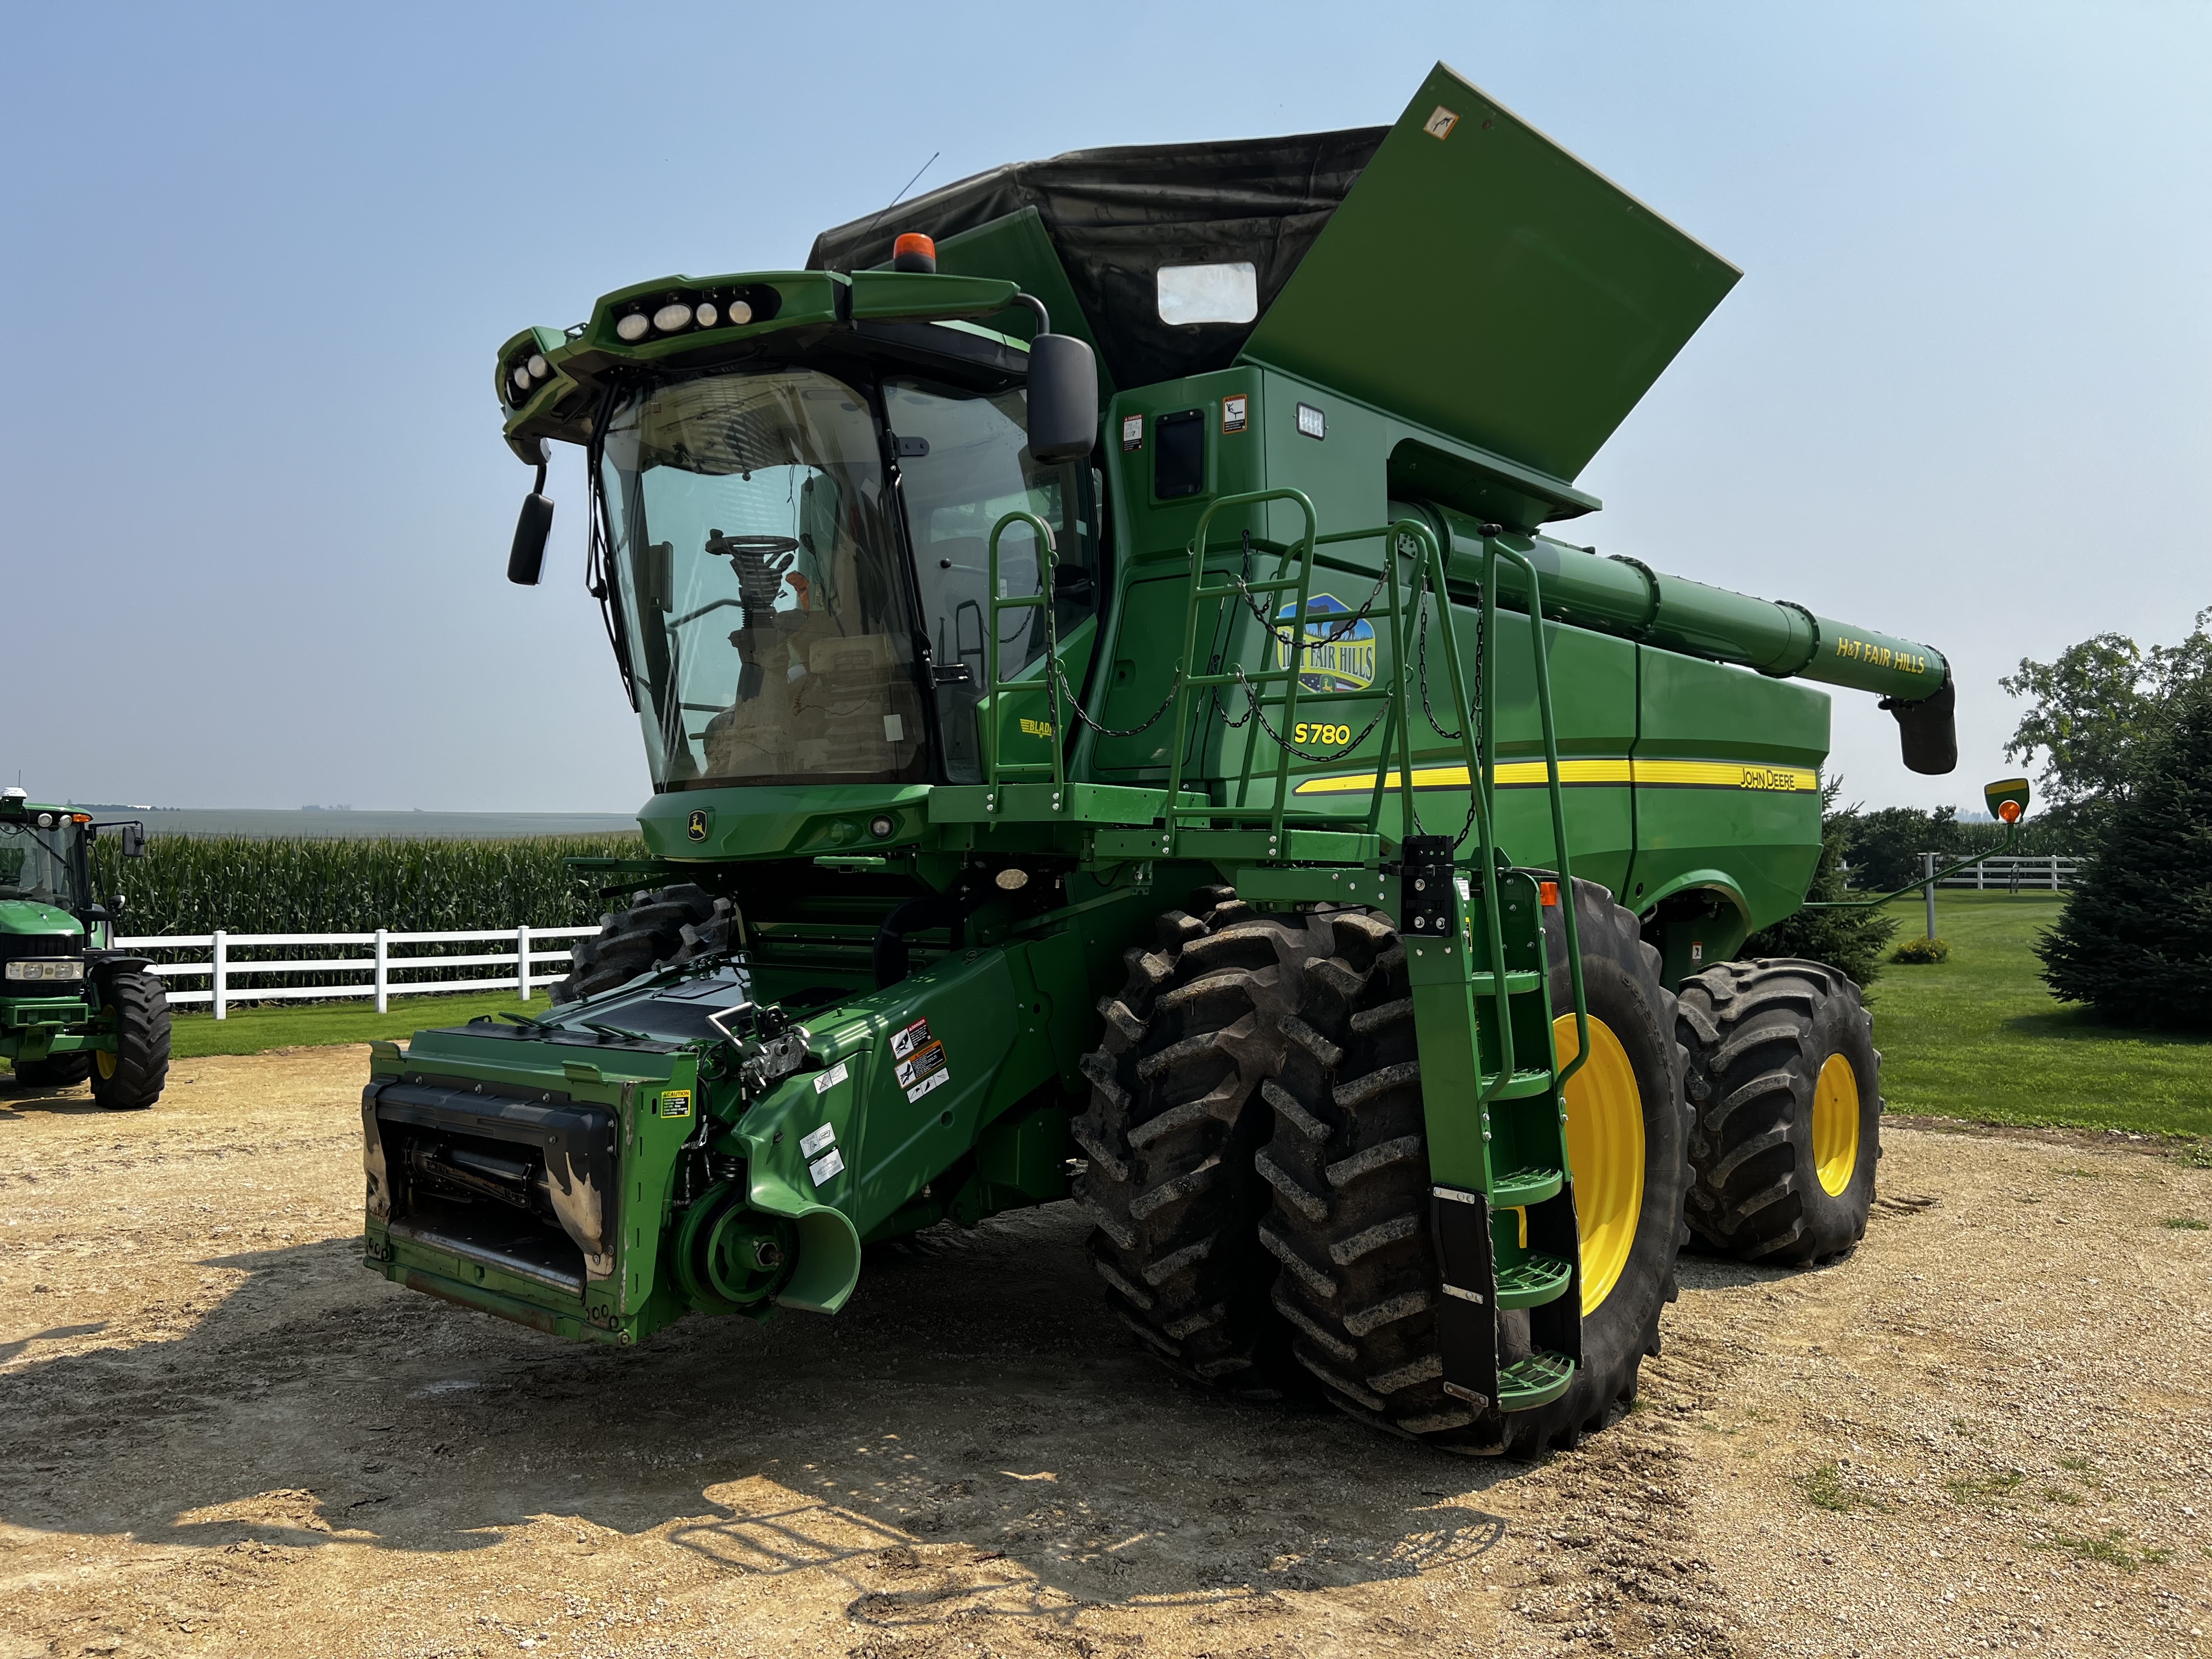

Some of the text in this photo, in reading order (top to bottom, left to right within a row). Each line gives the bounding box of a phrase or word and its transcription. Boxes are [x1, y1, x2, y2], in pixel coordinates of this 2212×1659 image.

[1310, 642, 1336, 670] FAIR
[1340, 646, 1373, 681] HILLS
[1836, 636, 1925, 675] H&T FAIR HILLS
[1294, 722, 1351, 746] S780
[1740, 768, 1796, 788] JOHN DEERE
[911, 1019, 926, 1030] DANGER
